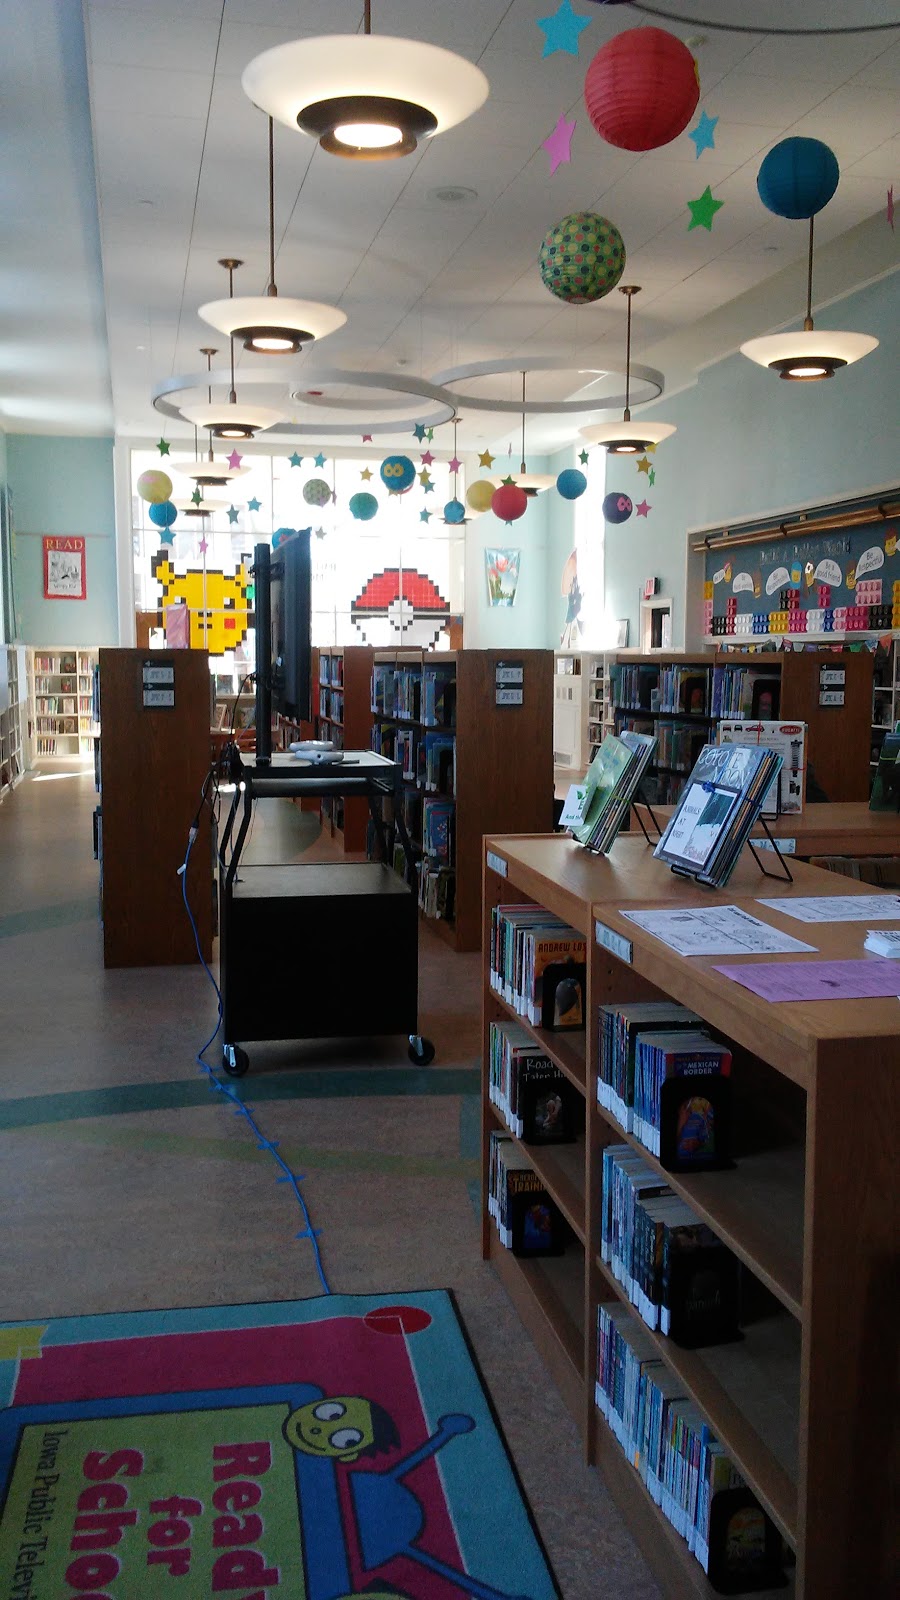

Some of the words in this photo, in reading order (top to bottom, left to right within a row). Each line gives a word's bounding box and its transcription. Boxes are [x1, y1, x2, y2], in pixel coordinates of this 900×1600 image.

[46, 539, 83, 549] READ
[866, 552, 873, 560] Be
[538, 942, 571, 953] ANDREW
[573, 941, 587, 952] LOS
[526, 1058, 554, 1071] Road
[683, 1067, 712, 1076] BORDER
[687, 1061, 719, 1069] MEXICAN
[513, 1177, 545, 1194] TRAINI
[36, 1428, 70, 1473] Iowa
[23, 1470, 60, 1536] Public
[64, 1447, 145, 1600] Scho
[211, 1441, 280, 1600] Read
[147, 1494, 204, 1577] for
